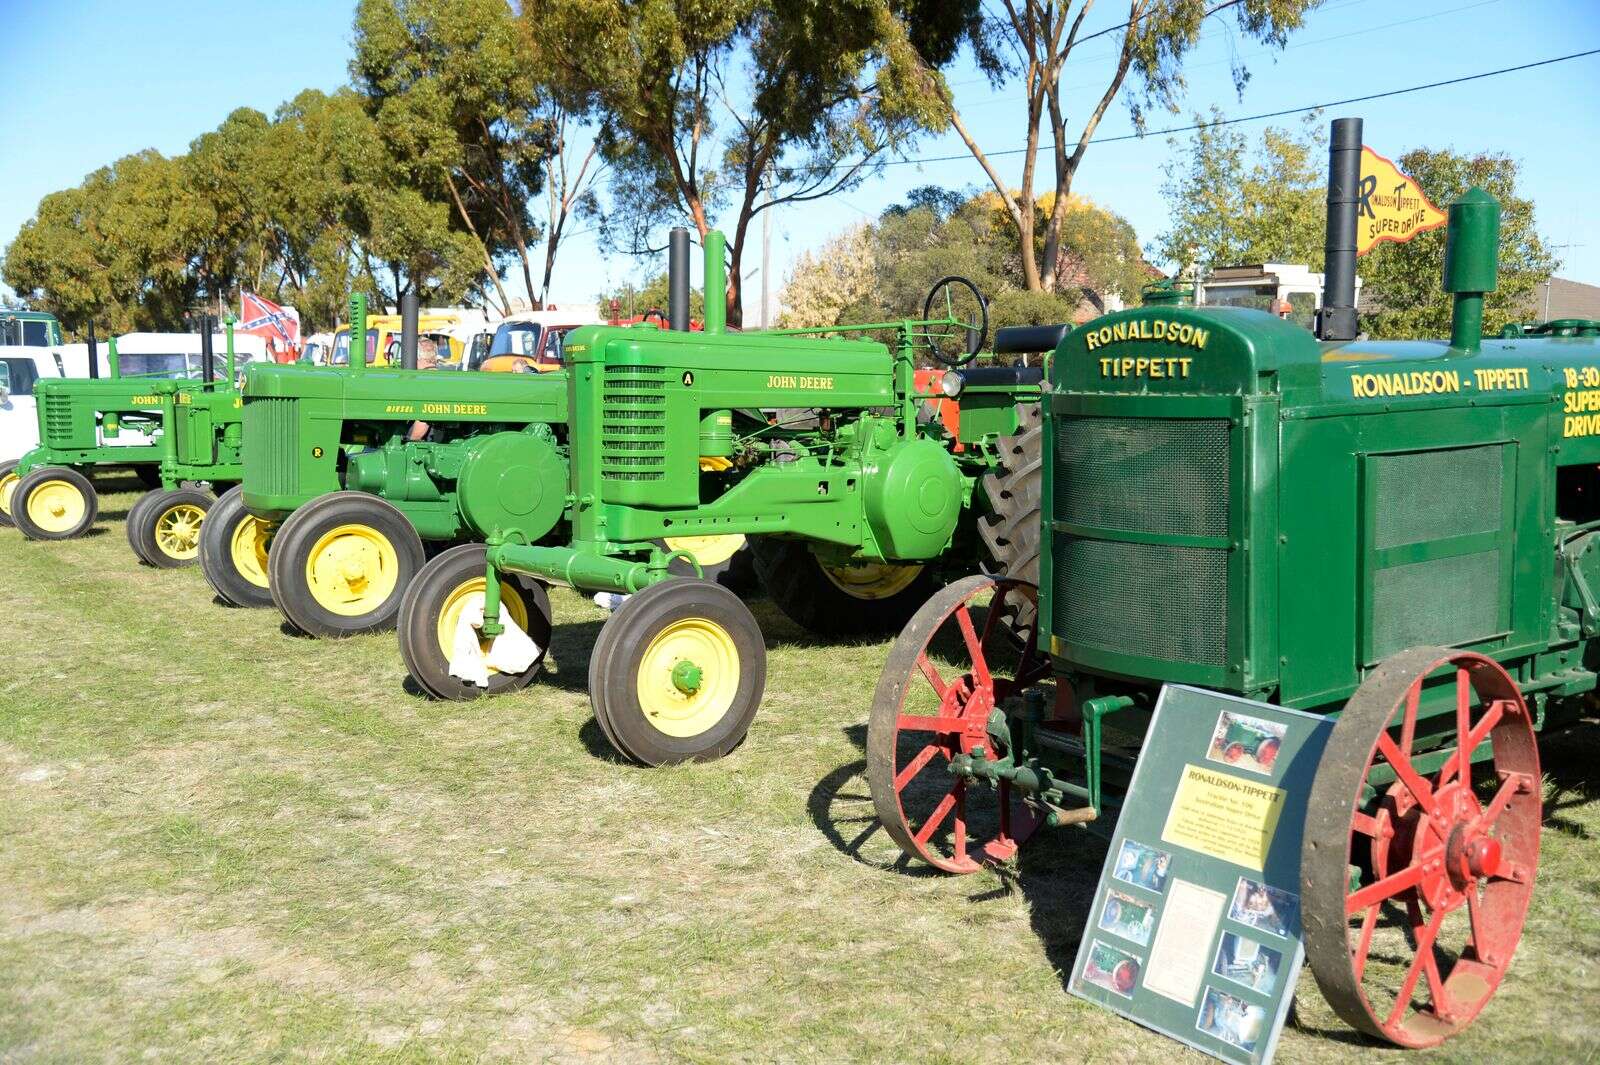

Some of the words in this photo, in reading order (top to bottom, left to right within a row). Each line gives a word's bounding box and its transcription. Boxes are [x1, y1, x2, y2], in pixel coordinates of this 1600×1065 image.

[1369, 218, 1400, 239] SUPER
[1401, 209, 1426, 234] DRIVE
[1085, 319, 1210, 350] RONALDSON
[1099, 357, 1193, 378] TIPPETT
[1563, 367, 1600, 389] 18-30
[683, 373, 693, 385] A
[767, 375, 797, 389] JOHN
[799, 376, 834, 390] DEERE
[1350, 370, 1460, 398] RONALDSON
[1473, 367, 1529, 391] TIPPETT
[131, 395, 159, 405] JOHN
[422, 403, 451, 414] JOHN
[453, 404, 487, 416] DEERE
[1188, 770, 1281, 803] RONALDSON-TIPPETT
